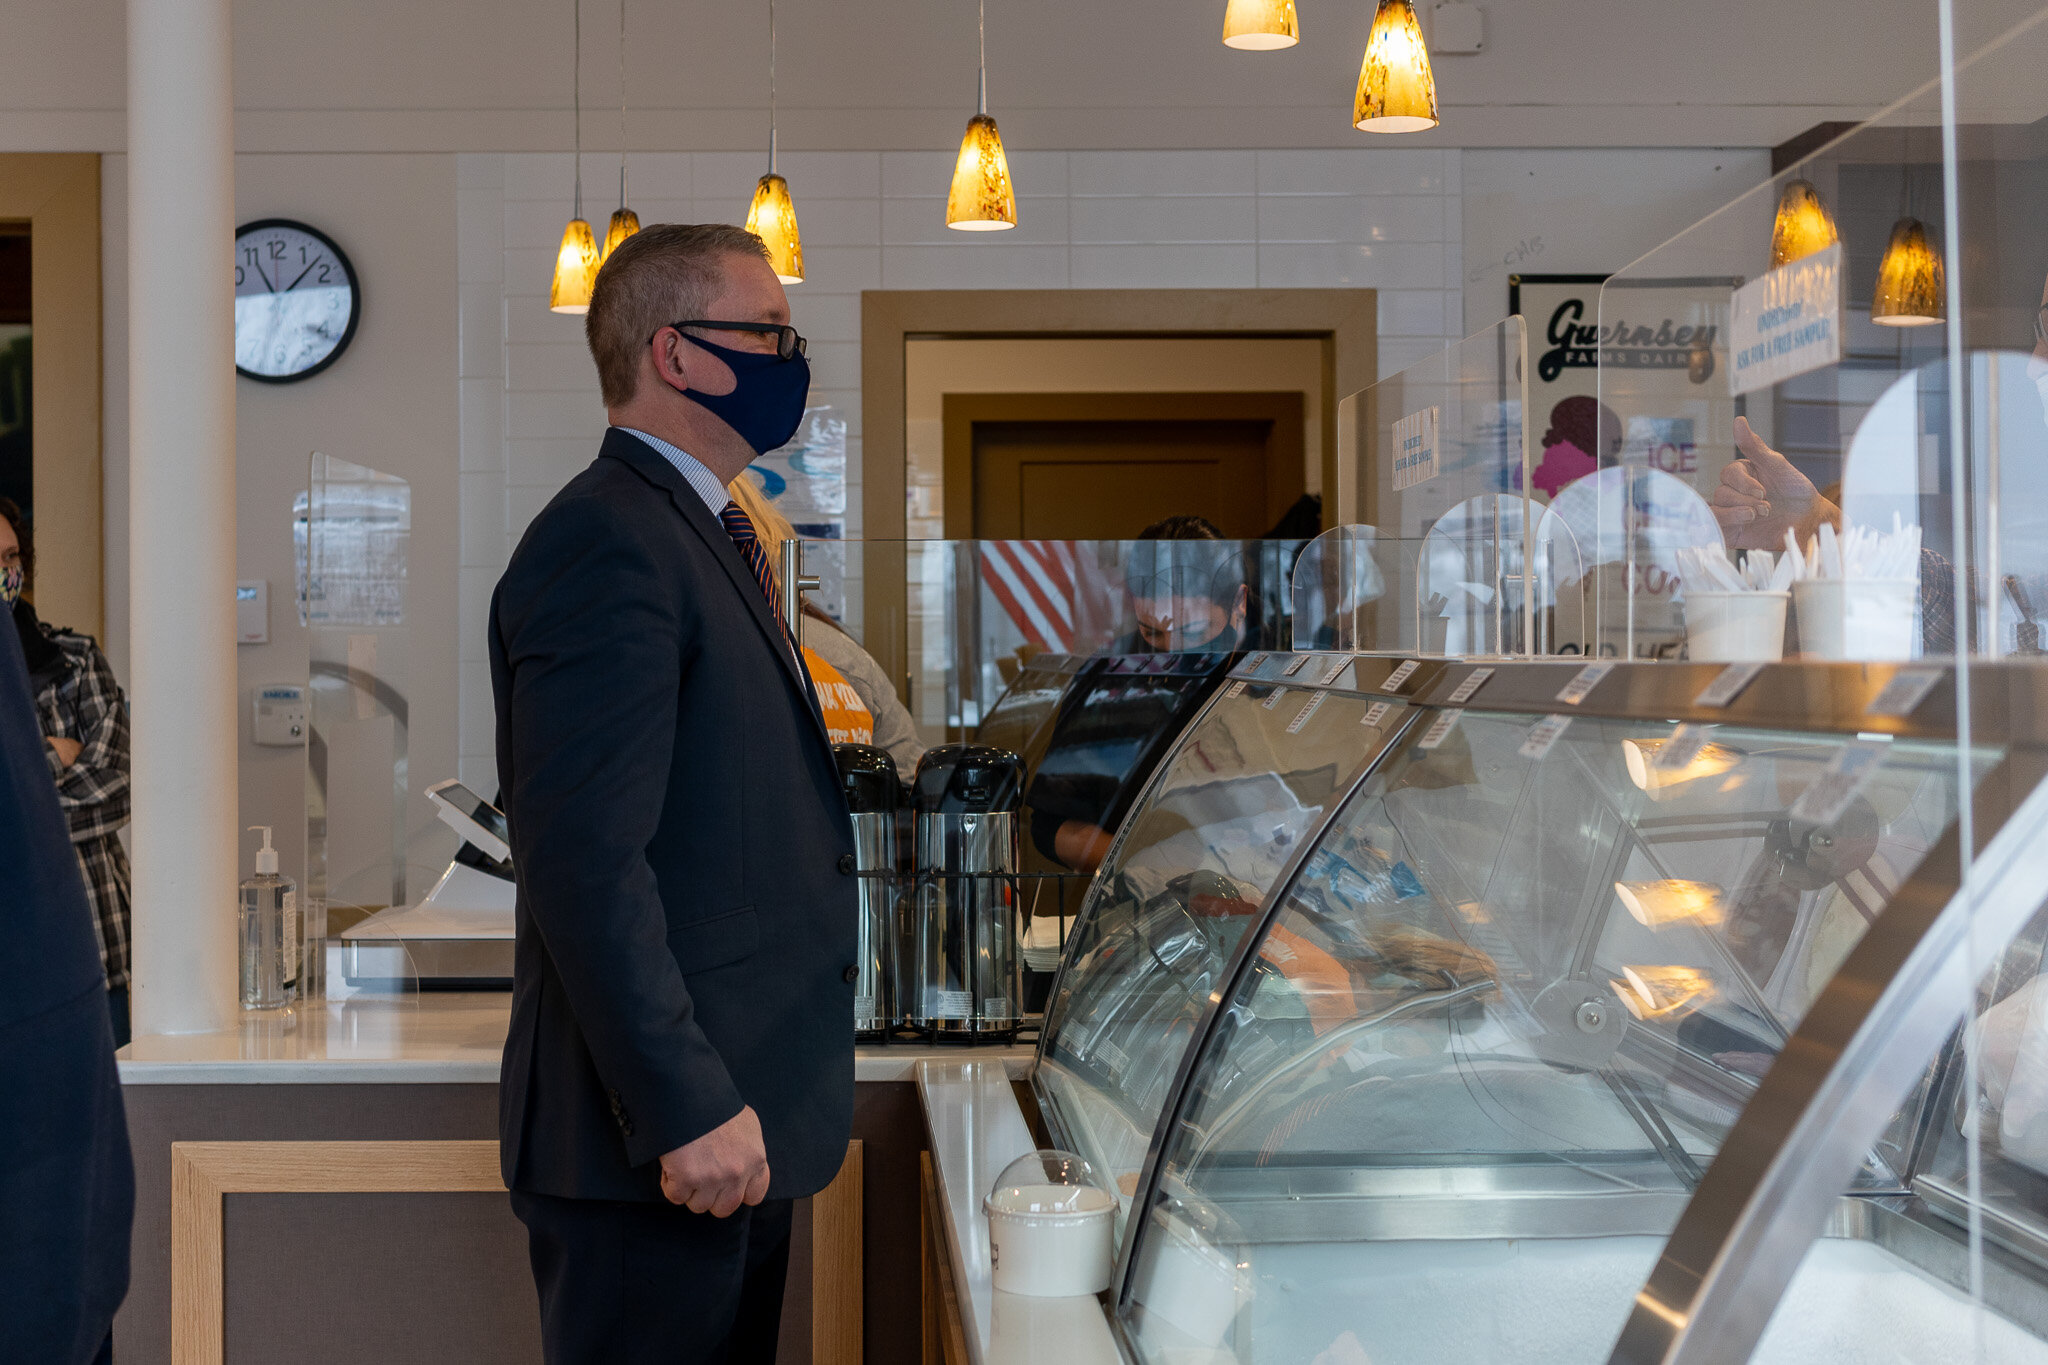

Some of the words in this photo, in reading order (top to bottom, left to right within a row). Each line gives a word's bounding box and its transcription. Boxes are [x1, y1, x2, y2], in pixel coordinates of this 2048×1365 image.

[244, 247, 259, 266] 11
[266, 240, 287, 260] 12
[299, 246, 307, 265] 1
[235, 265, 246, 287] 0
[317, 263, 332, 283] 2
[1539, 299, 1717, 382] Guernsey
[1640, 351, 1698, 365] DAIR
[1648, 442, 1697, 473] ICE
